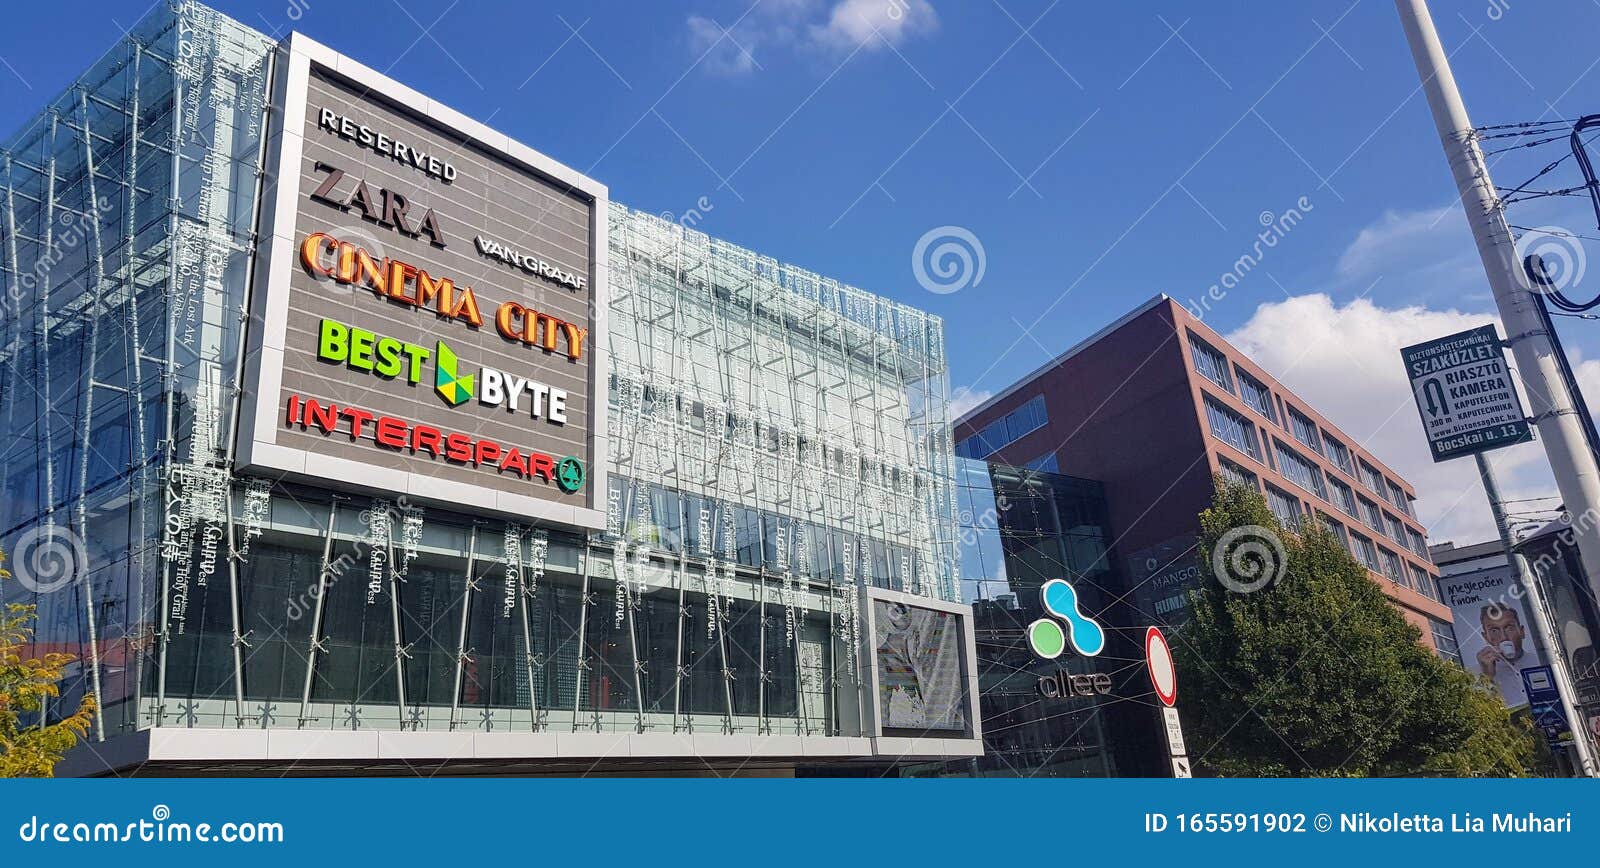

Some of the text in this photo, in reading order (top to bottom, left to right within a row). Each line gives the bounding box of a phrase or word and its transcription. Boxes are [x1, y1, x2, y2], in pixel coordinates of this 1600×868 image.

[186, 86, 200, 107] Holy
[252, 81, 262, 96] the
[250, 97, 261, 118] Lost
[248, 119, 260, 138] Ark
[320, 107, 457, 182] RESERVED
[310, 161, 447, 249] ZARA
[192, 265, 201, 280] of
[475, 234, 587, 290] VAN GRAAF
[189, 280, 201, 295] the
[299, 231, 484, 328] CINEMA
[495, 301, 588, 362] CITY
[187, 298, 200, 321] Lost
[183, 324, 196, 345] Ark
[1409, 335, 1490, 362] BIZTONSÁGTECHNIKAI
[1412, 344, 1494, 377] SZAKÜZLET
[318, 318, 568, 424] BEST BYTE
[1445, 362, 1501, 385] RIASZTÓ
[1449, 377, 1506, 400] KAMERA
[1454, 392, 1510, 410] KAPUTELEFON
[1457, 403, 1514, 421] KAPUTECHNIKA
[1430, 419, 1444, 428] 300
[287, 394, 556, 483] INTERSPAR
[1436, 424, 1522, 453] Bocskai u. 13.
[610, 489, 622, 537] Brazil
[180, 531, 190, 548] and
[699, 509, 711, 555] Brazil
[178, 550, 190, 566] the
[203, 527, 223, 575] Gump
[172, 567, 188, 591] Holy
[369, 550, 387, 593] Gump
[1152, 566, 1197, 591] MANGO
[504, 569, 520, 608] Gump
[171, 595, 185, 619] Grail
[1039, 667, 1112, 698] allee
